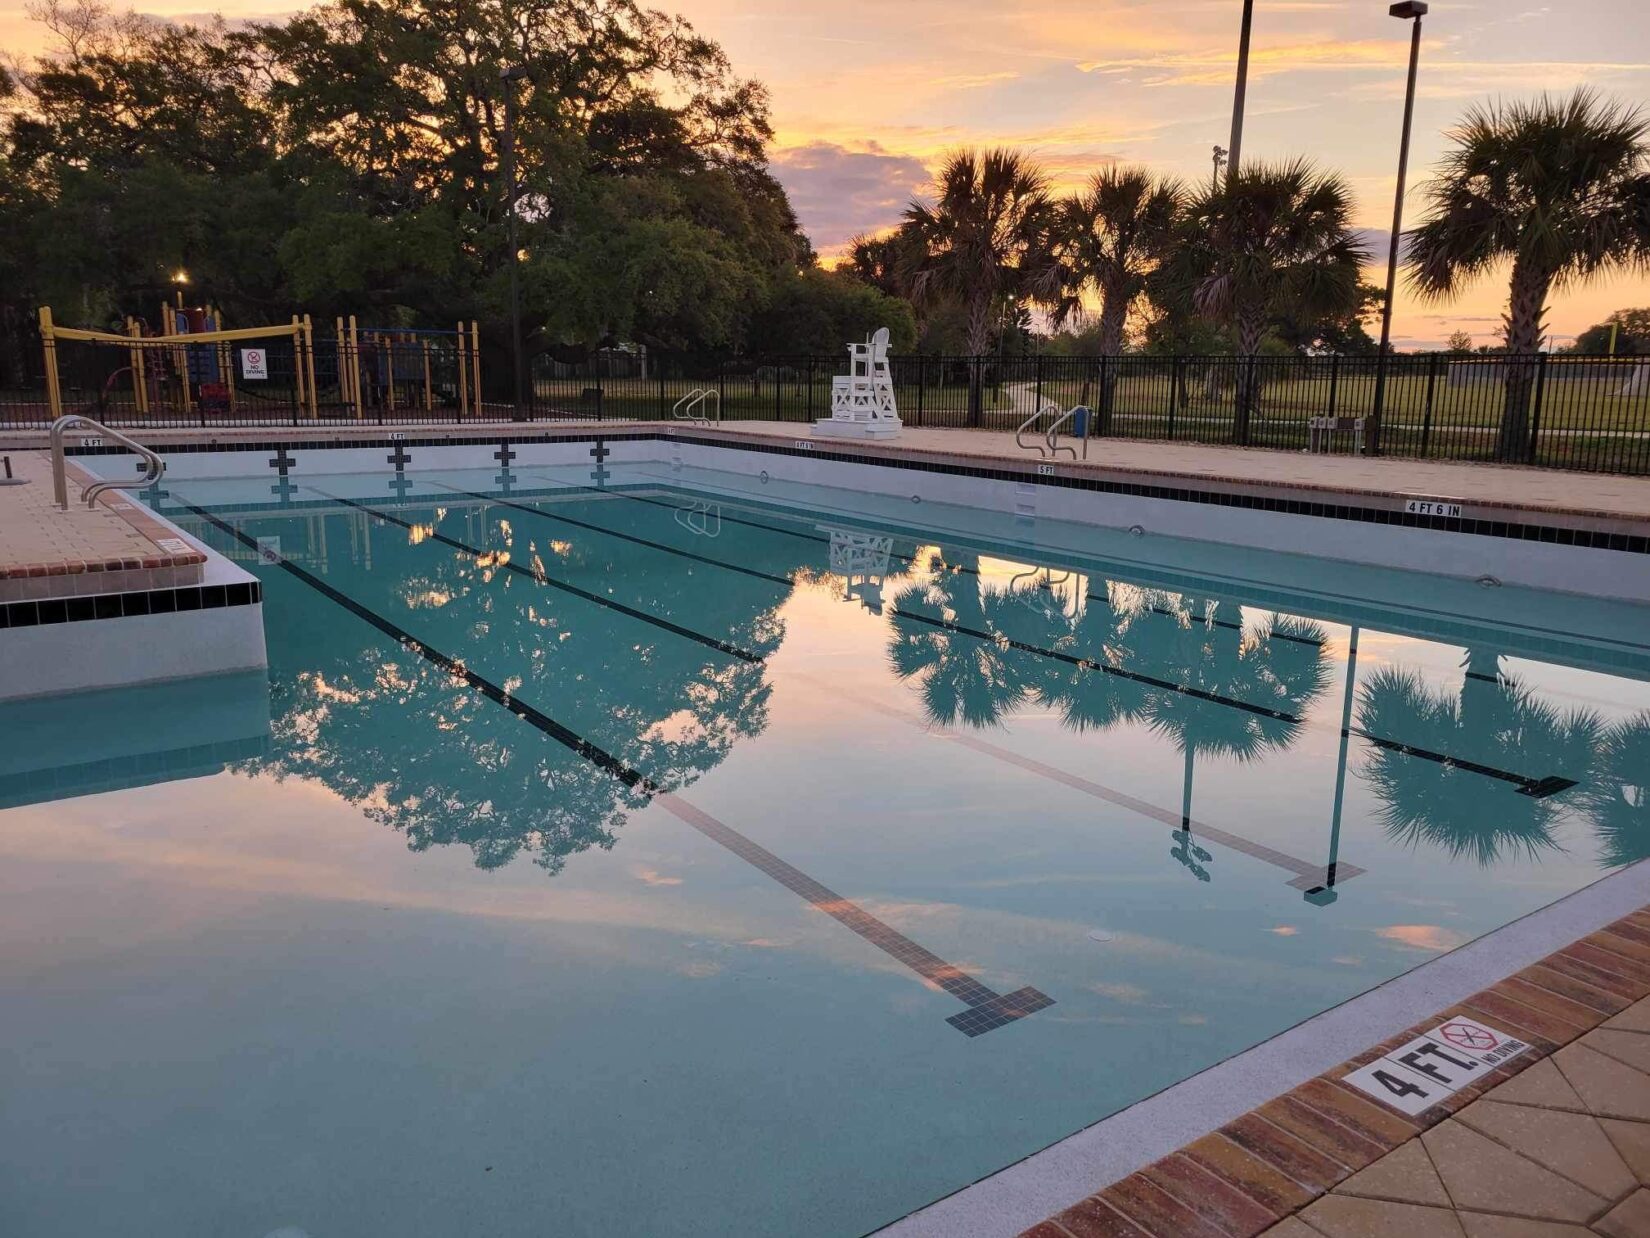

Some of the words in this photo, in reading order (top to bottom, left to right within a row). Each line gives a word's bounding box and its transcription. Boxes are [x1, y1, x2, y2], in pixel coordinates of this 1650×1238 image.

[1409, 502, 1416, 512] 4
[1420, 503, 1432, 513] FT
[1437, 505, 1443, 514] 6
[1449, 505, 1460, 516] IN
[1481, 1053, 1500, 1064] NO
[1499, 1040, 1525, 1058] DIVING
[1371, 1069, 1429, 1099] 4
